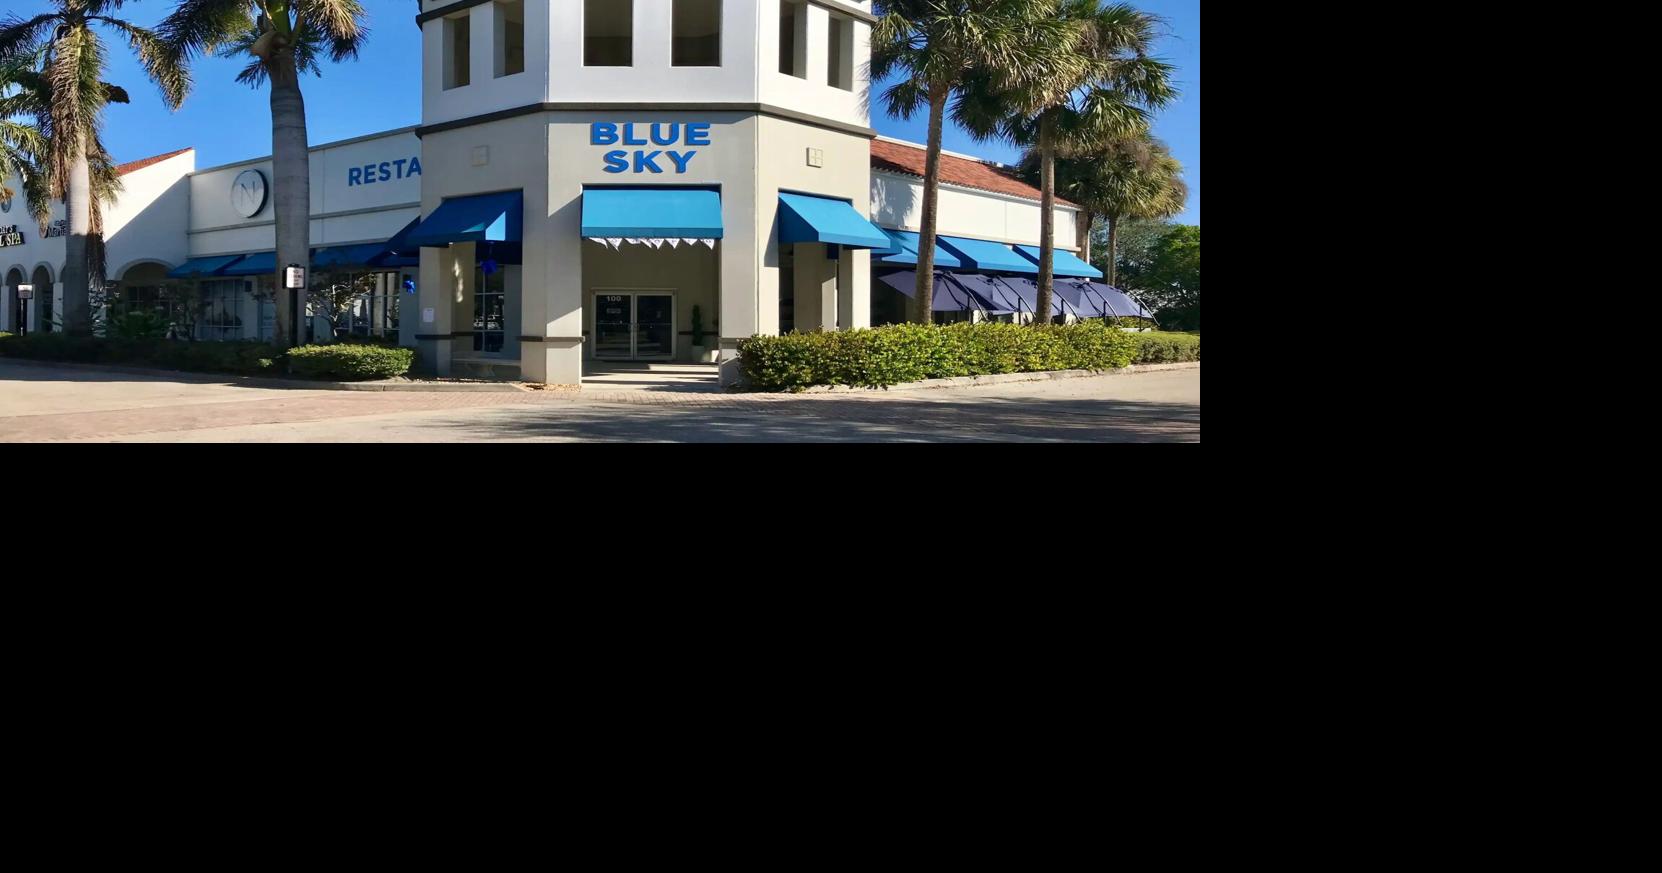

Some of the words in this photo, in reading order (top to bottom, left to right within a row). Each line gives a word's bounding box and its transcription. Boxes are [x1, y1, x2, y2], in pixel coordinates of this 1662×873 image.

[590, 121, 711, 146] BLUE
[348, 156, 422, 187] RESTA
[602, 150, 697, 174] SKY
[6, 232, 22, 246] SPA
